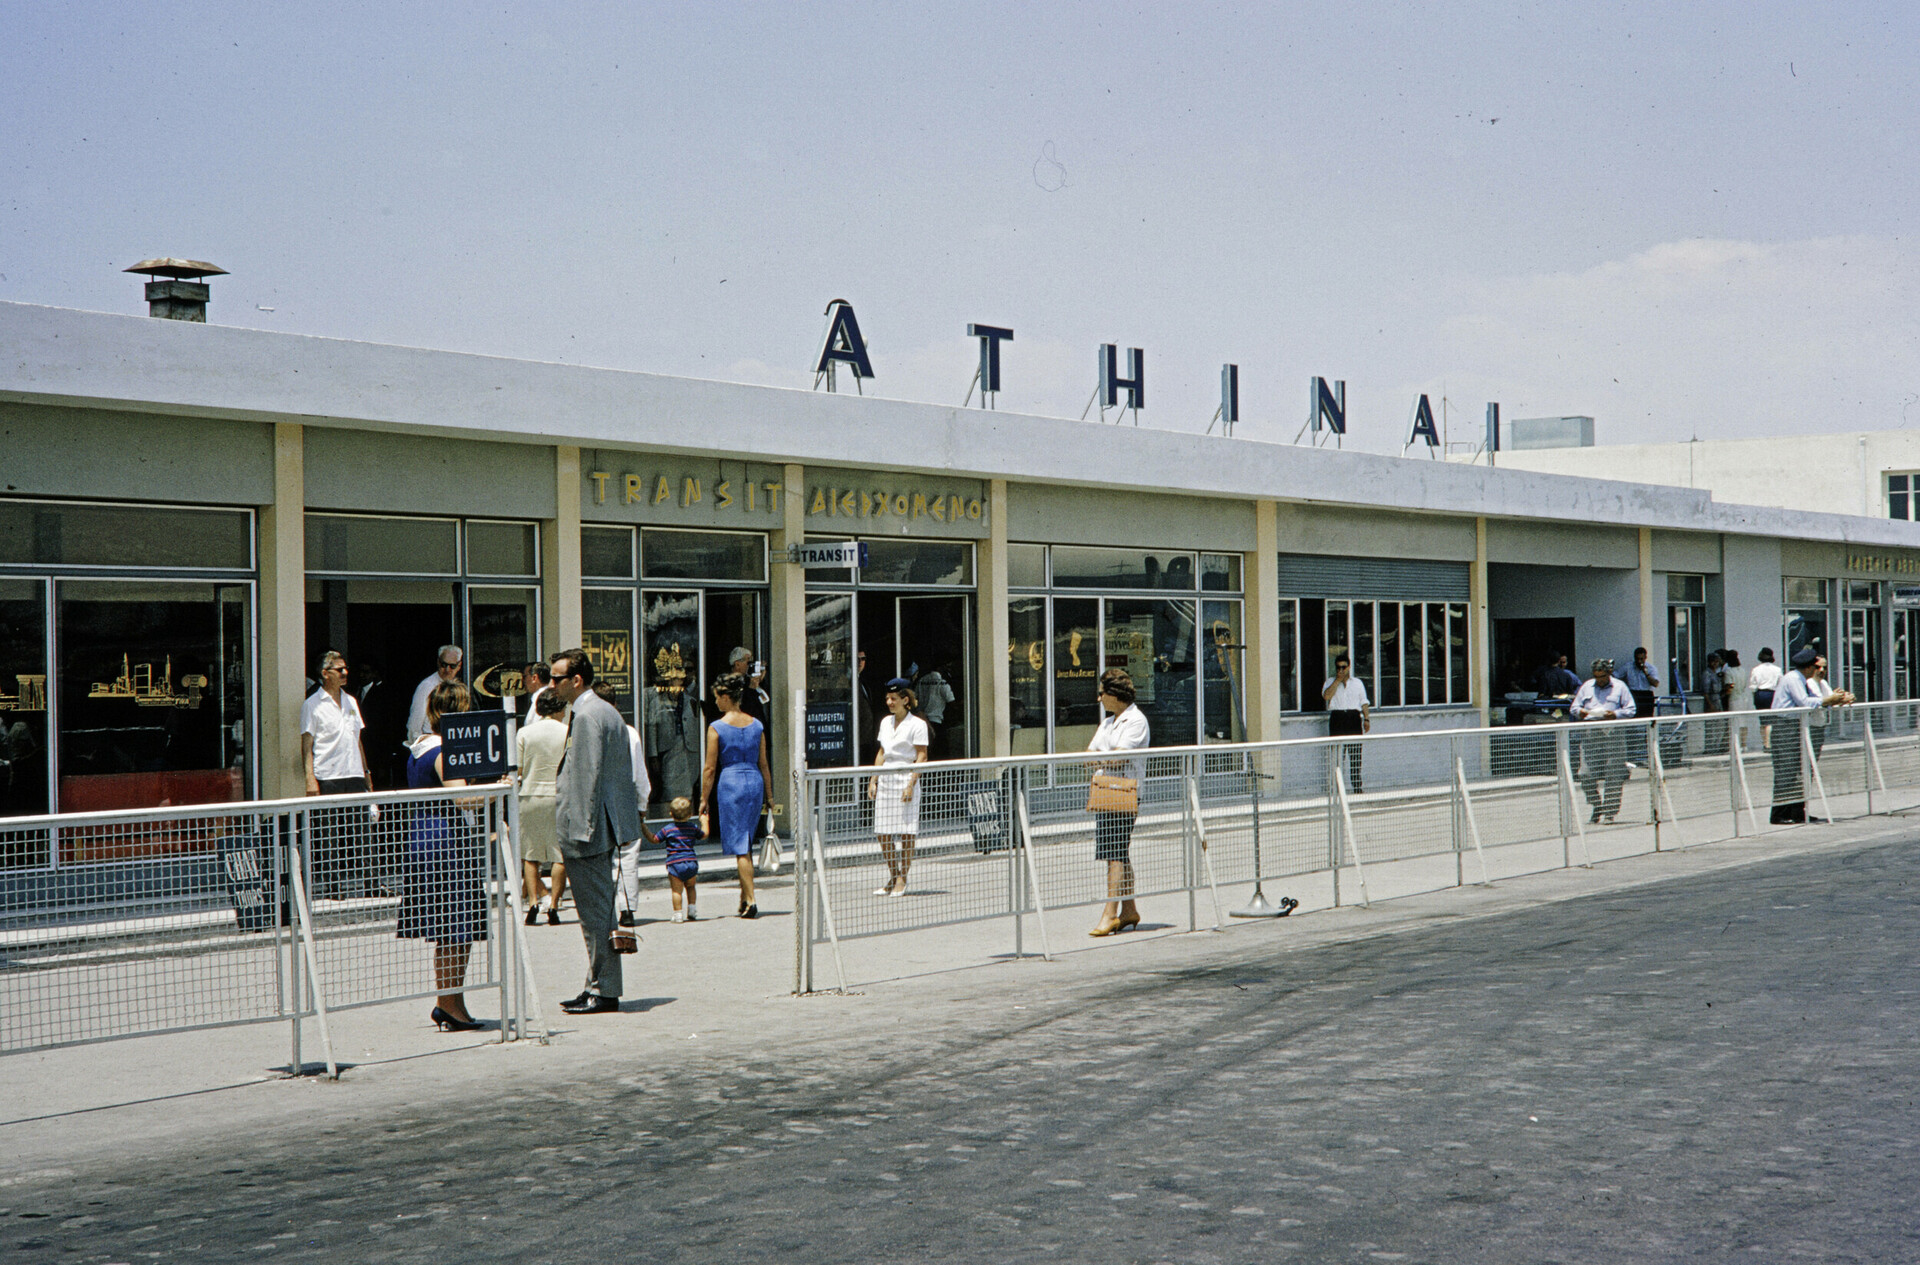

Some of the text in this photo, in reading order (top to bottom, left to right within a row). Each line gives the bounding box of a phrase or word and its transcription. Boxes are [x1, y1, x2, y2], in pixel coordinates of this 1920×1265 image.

[810, 299, 1500, 452] ATHINAI
[590, 472, 782, 511] TRANSIT
[801, 548, 855, 563] TRANSIT
[448, 726, 481, 740] ΠΥΛΗ
[487, 724, 500, 763] C
[449, 752, 482, 766] GATE
[968, 791, 997, 815] CHAT
[975, 820, 1000, 837] TOURS
[225, 849, 259, 881] CHAT
[236, 888, 265, 909] TOURS
